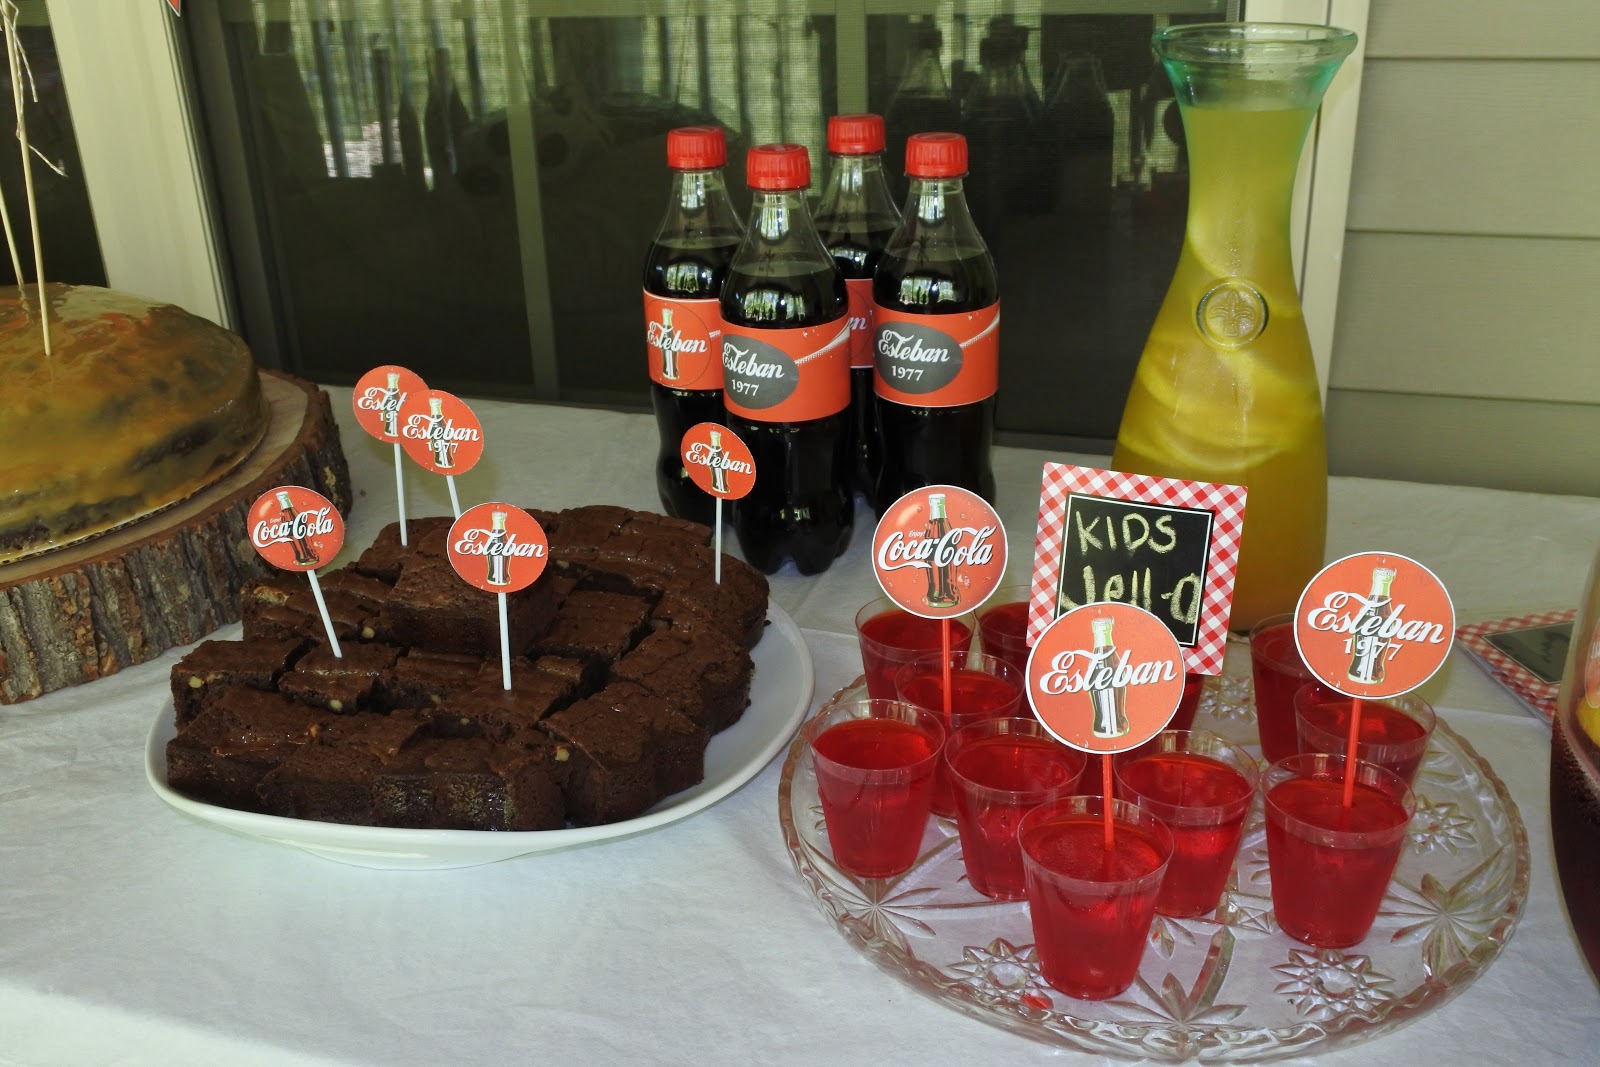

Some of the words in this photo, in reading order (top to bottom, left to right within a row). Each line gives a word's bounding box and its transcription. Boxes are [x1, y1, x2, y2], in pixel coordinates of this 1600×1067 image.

[647, 321, 708, 353] Esteban
[878, 329, 951, 363] Esteban
[722, 342, 785, 379] Esteban
[891, 365, 924, 381] 1977
[357, 387, 407, 412] Este
[731, 379, 760, 396] 1977
[402, 414, 480, 442] Esteban
[426, 441, 459, 454] 1977
[685, 442, 753, 475] Esteban
[253, 507, 334, 548] Coca-Cola
[454, 528, 546, 559] Esteban
[1076, 511, 1177, 556] KIDS
[878, 525, 998, 571] Coca-Cola
[1307, 591, 1447, 644] Esteban
[1343, 637, 1403, 661] 1977
[1039, 647, 1178, 696] Esteban
